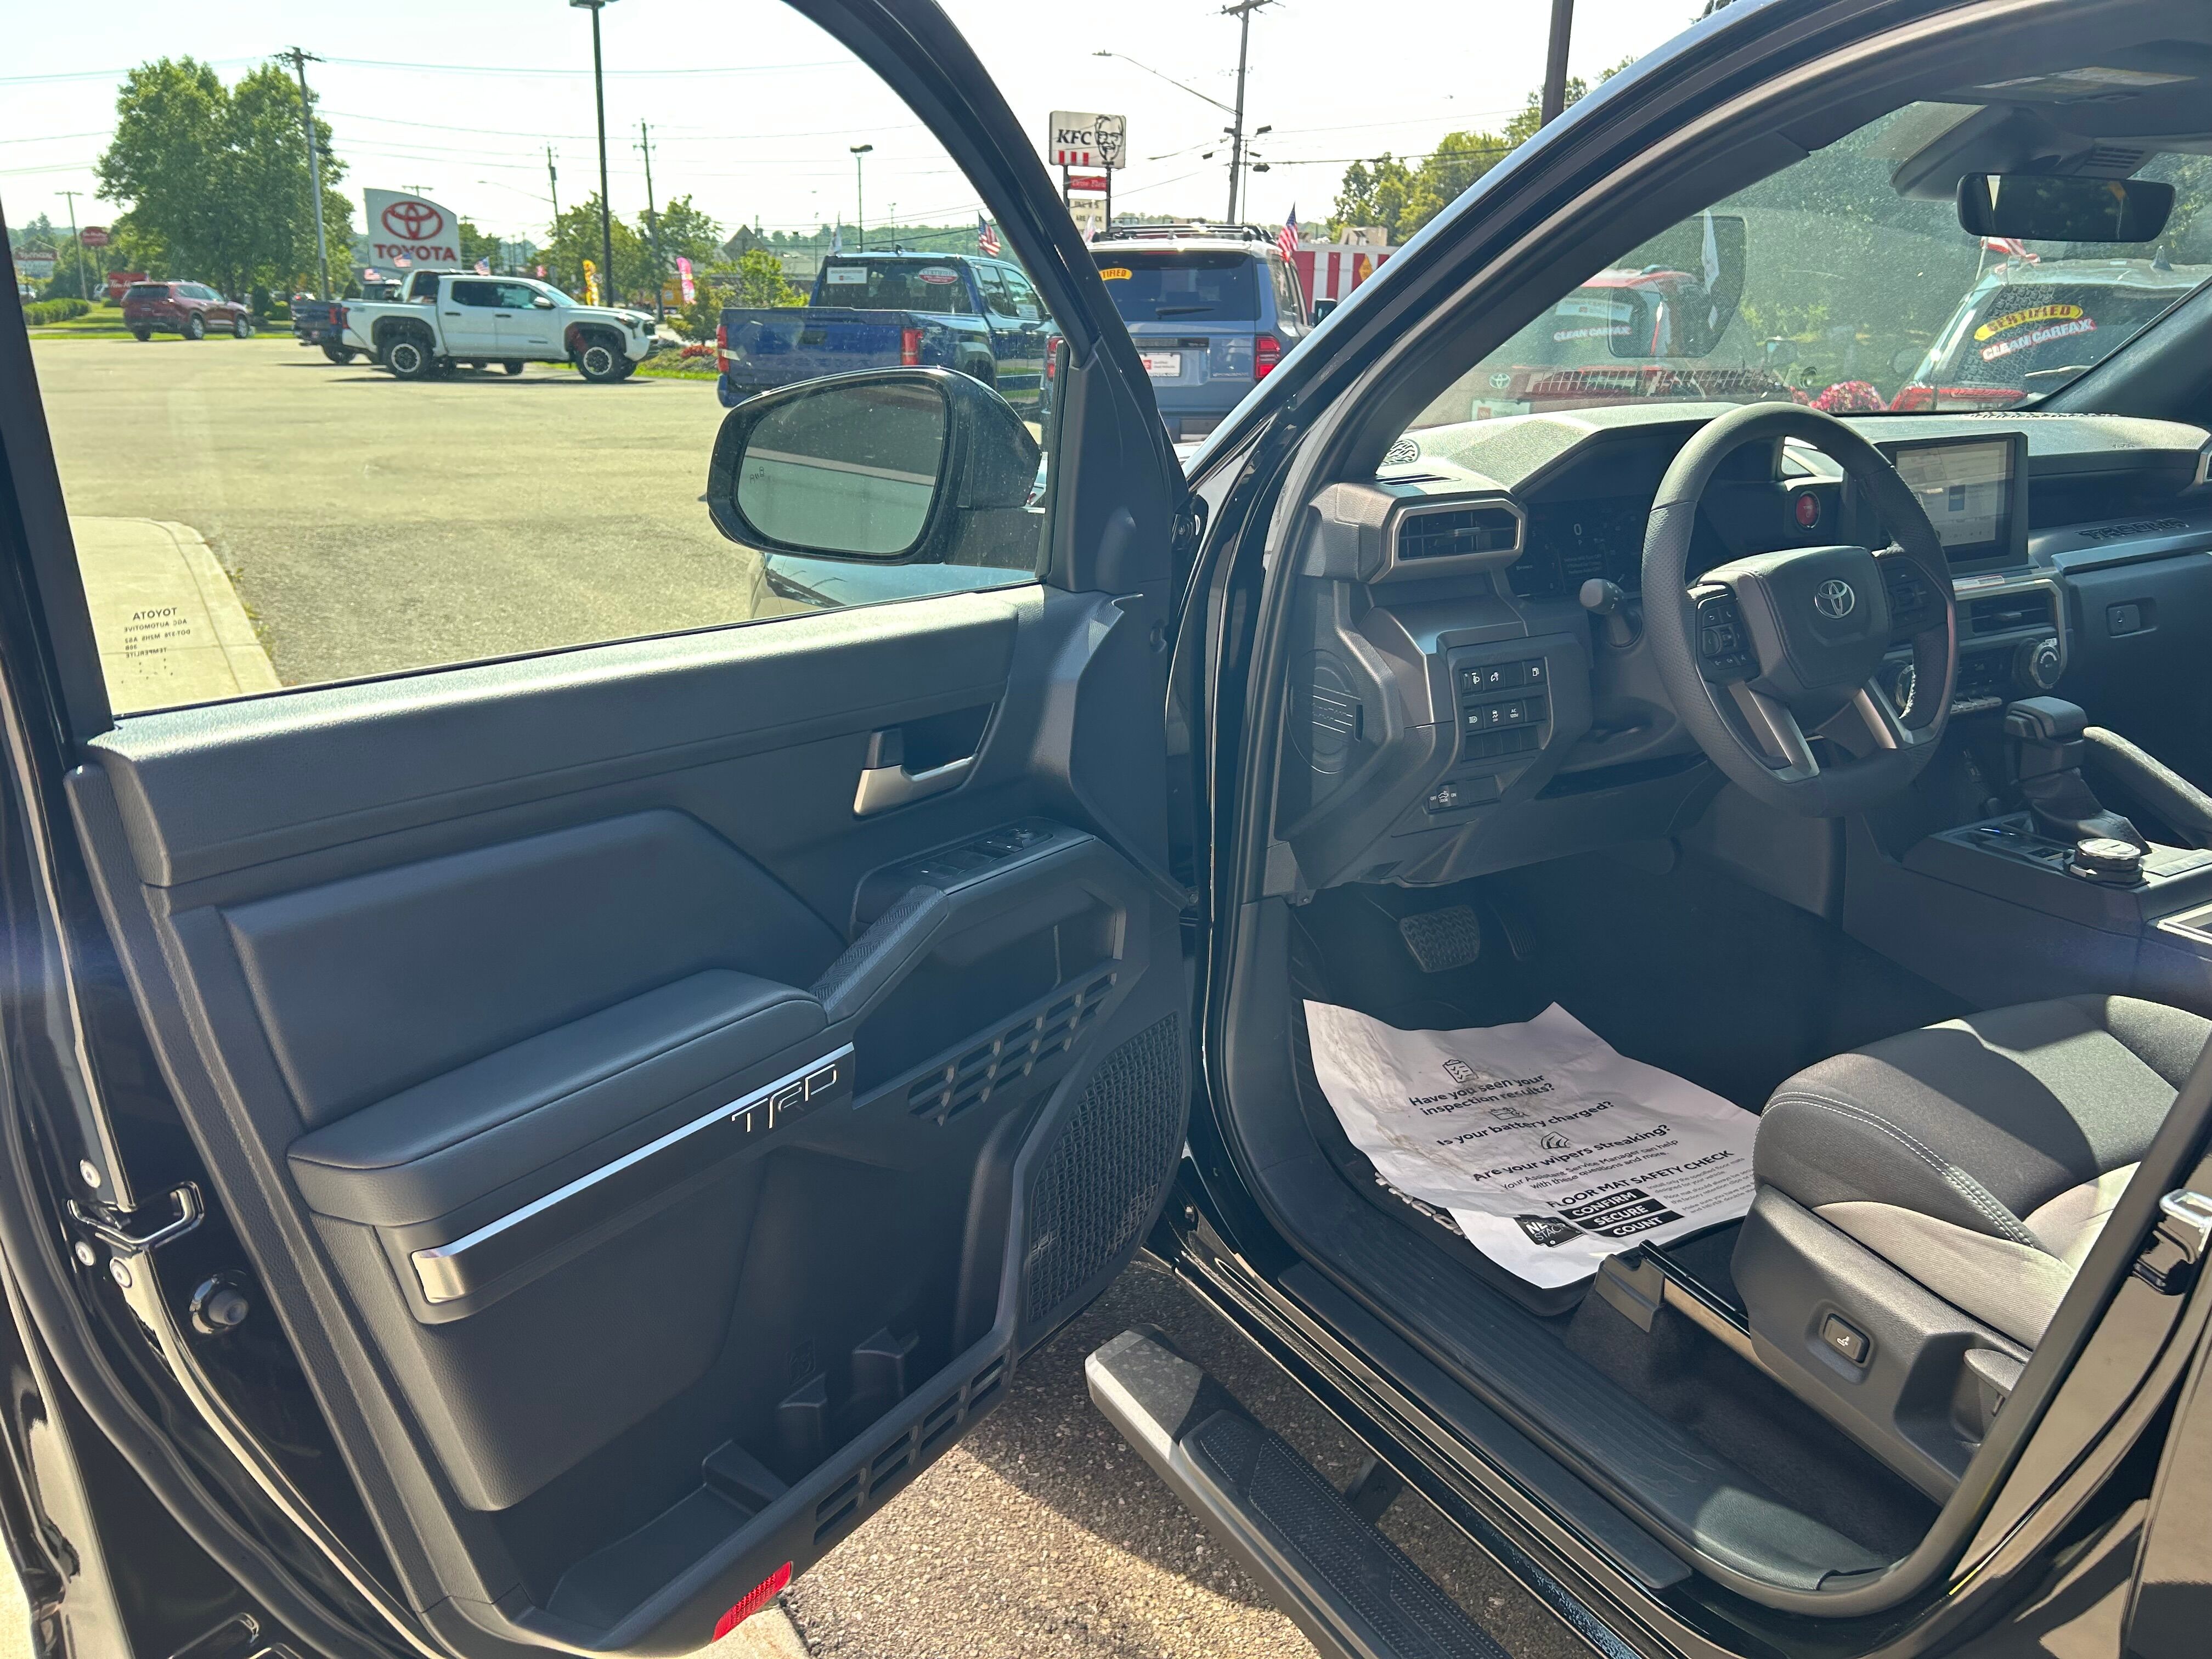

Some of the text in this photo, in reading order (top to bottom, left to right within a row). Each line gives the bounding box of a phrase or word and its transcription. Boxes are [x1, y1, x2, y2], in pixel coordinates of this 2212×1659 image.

[1056, 129, 1092, 145] KFC
[373, 243, 457, 261] TOYOTA
[1102, 269, 1127, 279] TIFIED
[1554, 325, 1632, 341] CLEAN CARFAX
[1987, 306, 2071, 331] CERTIFIED
[1982, 318, 2091, 362] CLEAN CARFAX
[731, 1063, 837, 1133] TRD
[1408, 1075, 1545, 1107] Have you seen your
[1419, 1082, 1555, 1115] inspection results?
[1453, 1129, 1489, 1144] your
[1487, 1120, 1547, 1133] battery
[1548, 1101, 1615, 1124] charged?
[1473, 1125, 1670, 1181] Are your wipers streaking?
[1500, 1178, 1523, 1189] Your
[1525, 1171, 1567, 1182] Assistant
[1566, 1161, 1600, 1172] Service
[1599, 1150, 1640, 1164] Manager
[1656, 1139, 1679, 1150] help
[1530, 1180, 1552, 1189] with
[1551, 1175, 1578, 1184] these
[1578, 1162, 1624, 1177] questions
[1624, 1156, 1642, 1165] and
[1545, 1150, 1735, 1207] FLOOR MAT SAFETY CHECK
[1572, 1191, 1638, 1216] CONFIRM
[1593, 1205, 1649, 1226] SECURE
[1612, 1216, 1664, 1235] COUNT
